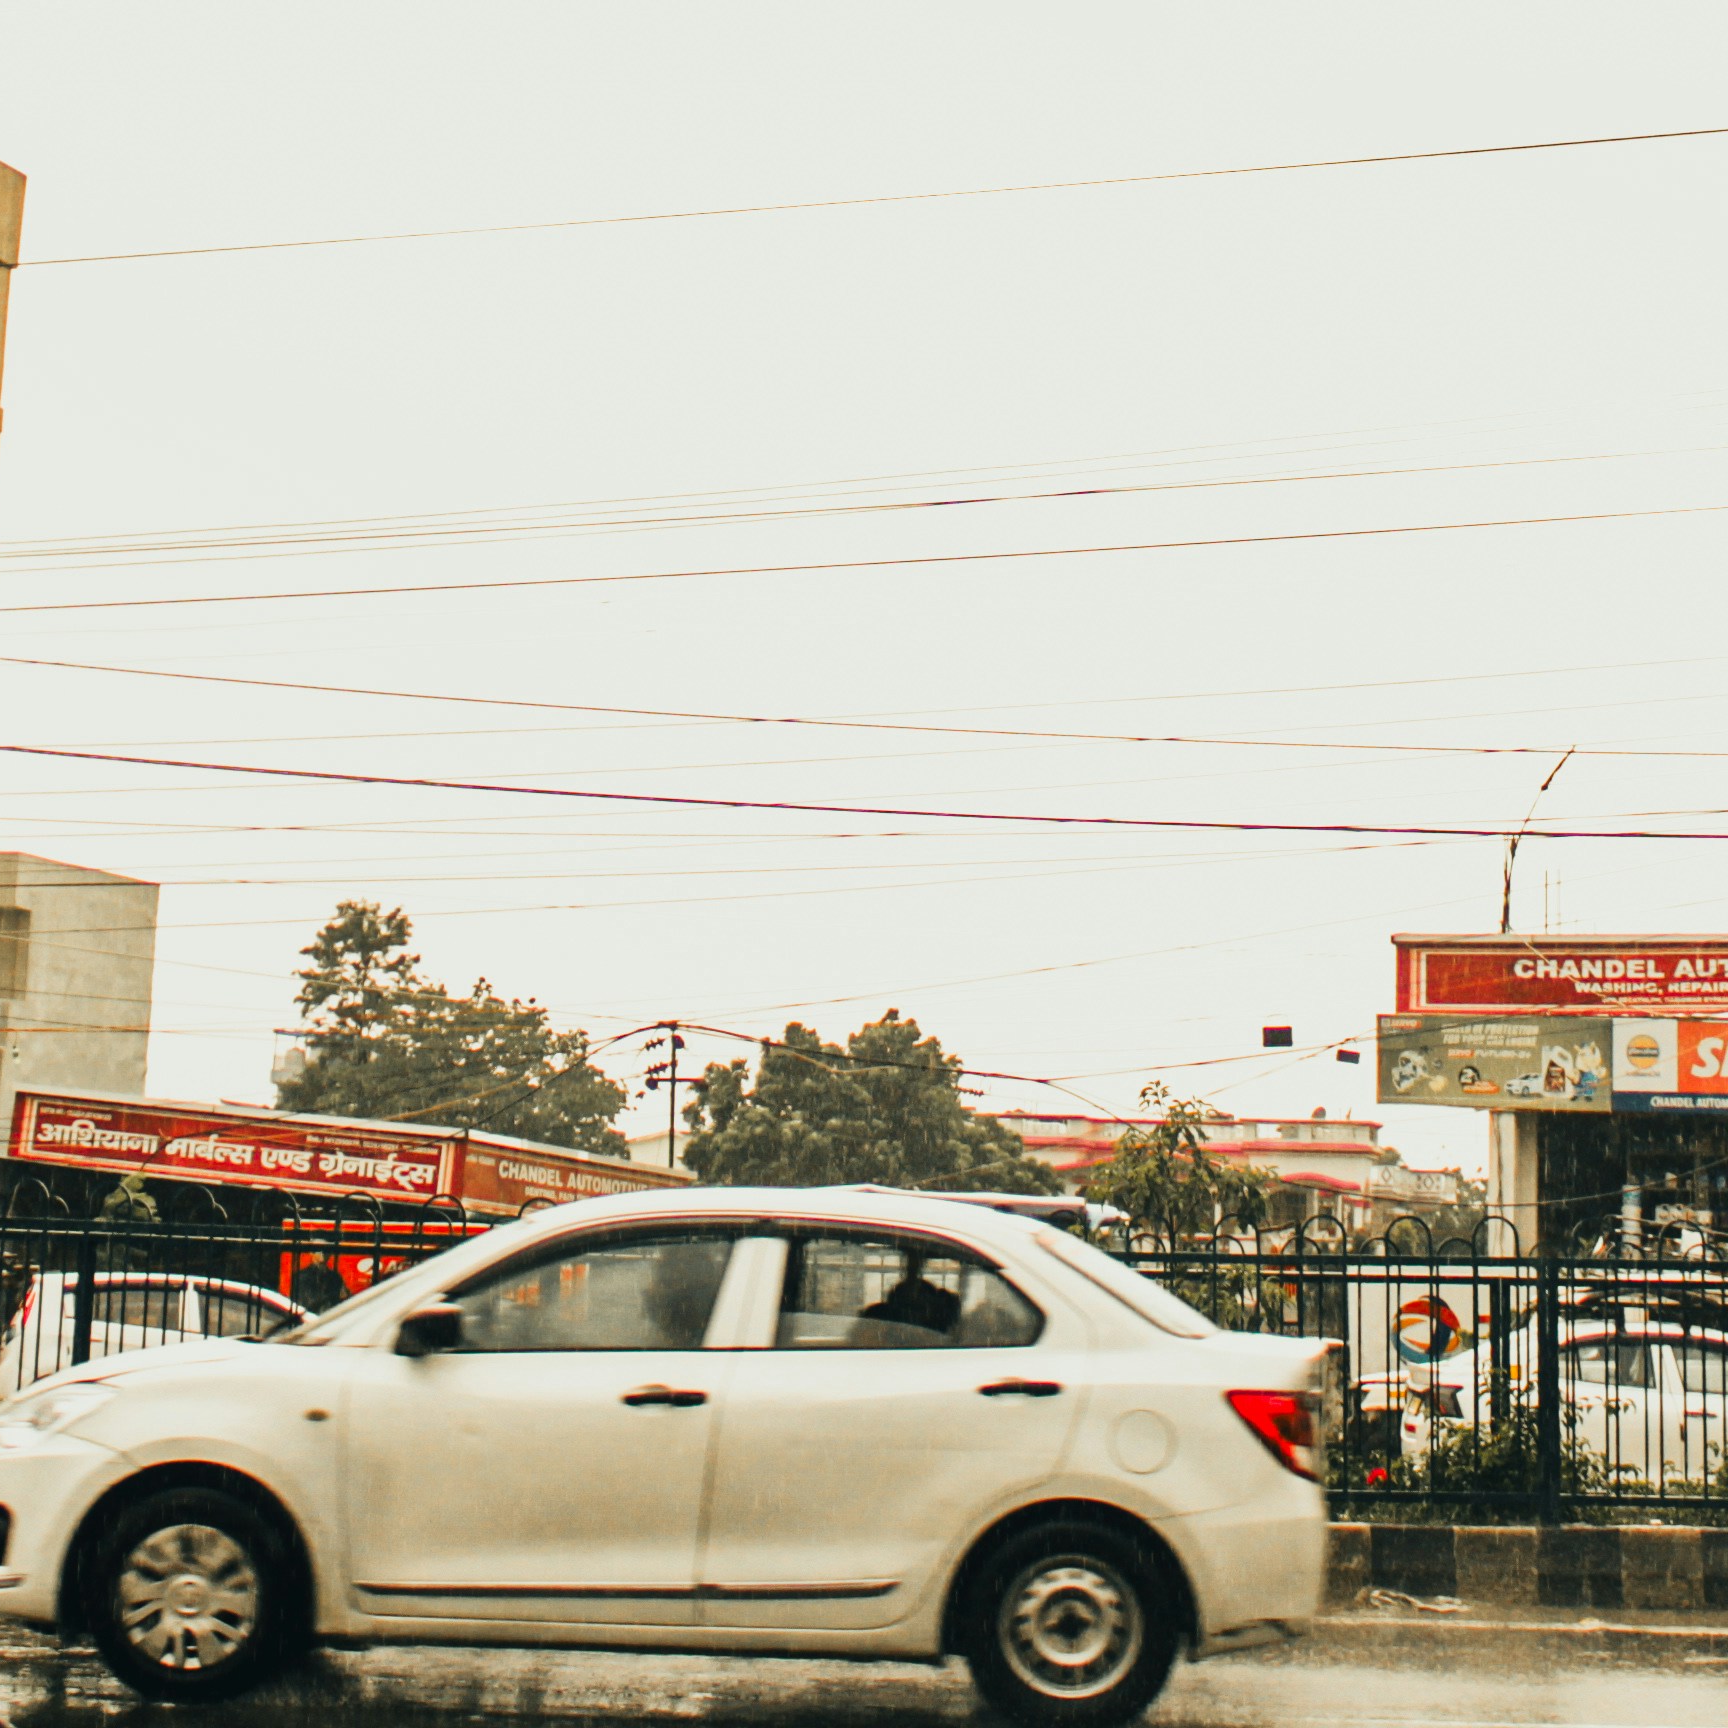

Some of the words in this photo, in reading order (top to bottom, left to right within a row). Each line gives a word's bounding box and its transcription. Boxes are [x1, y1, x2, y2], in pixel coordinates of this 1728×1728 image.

[1514, 958, 1665, 979] CHANDEL
[1575, 982, 1664, 995] WASHING,
[1650, 1095, 1695, 1109] CHANDEL
[37, 1119, 159, 1154] आशियाना
[165, 1134, 255, 1165] मार्बल्स
[261, 1147, 314, 1172] एण्ड
[498, 1159, 563, 1187] CHANDEL
